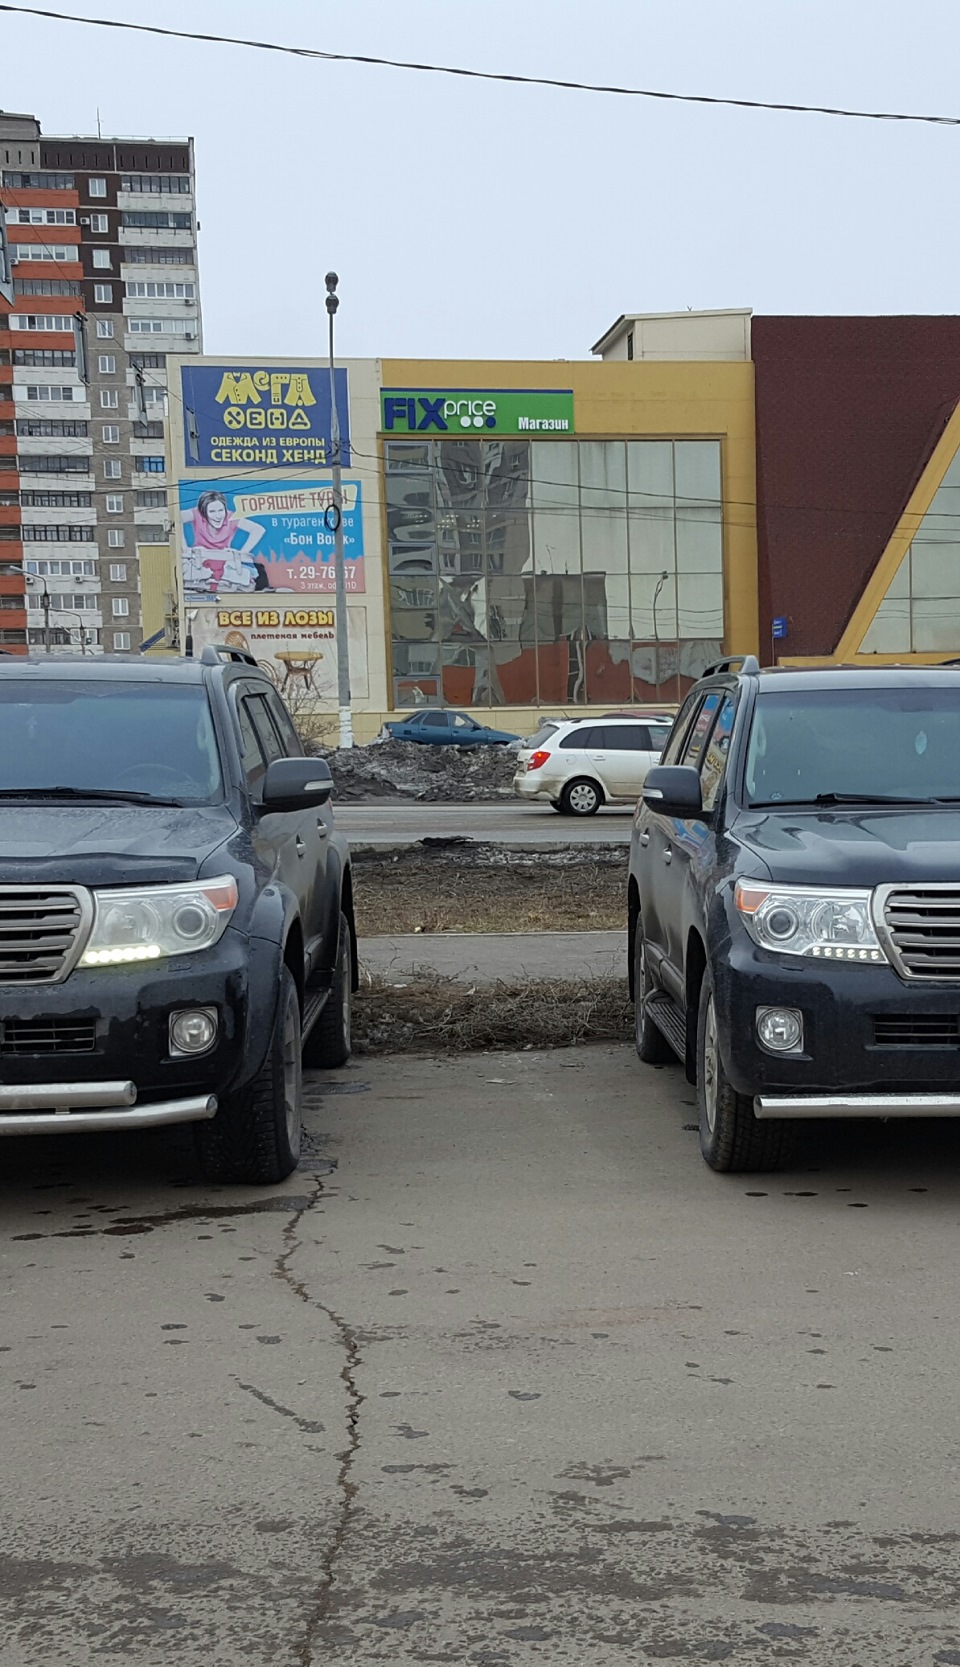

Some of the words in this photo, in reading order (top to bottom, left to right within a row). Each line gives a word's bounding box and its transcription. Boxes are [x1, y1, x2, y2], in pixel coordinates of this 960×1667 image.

[444, 400, 497, 419] price
[223, 406, 311, 430] ХЕНД
[518, 416, 569, 431] Магазин
[210, 436, 259, 447] ОДЕЖДА
[262, 437, 276, 447] ИЗ
[279, 437, 325, 447] ЕВРОПЫ
[210, 449, 278, 464] СЕКОНД
[283, 449, 327, 465] ХЕНД
[241, 493, 306, 512] ГОРЯЩИЕ
[271, 518, 278, 527] в
[284, 532, 313, 545] «Бон
[287, 568, 297, 579] т.
[217, 610, 253, 627] ВСЕ
[256, 610, 280, 627] ИЗ
[283, 610, 335, 627] ЛОЗЫ
[251, 632, 298, 640] плетеная
[301, 631, 335, 640] мебель
